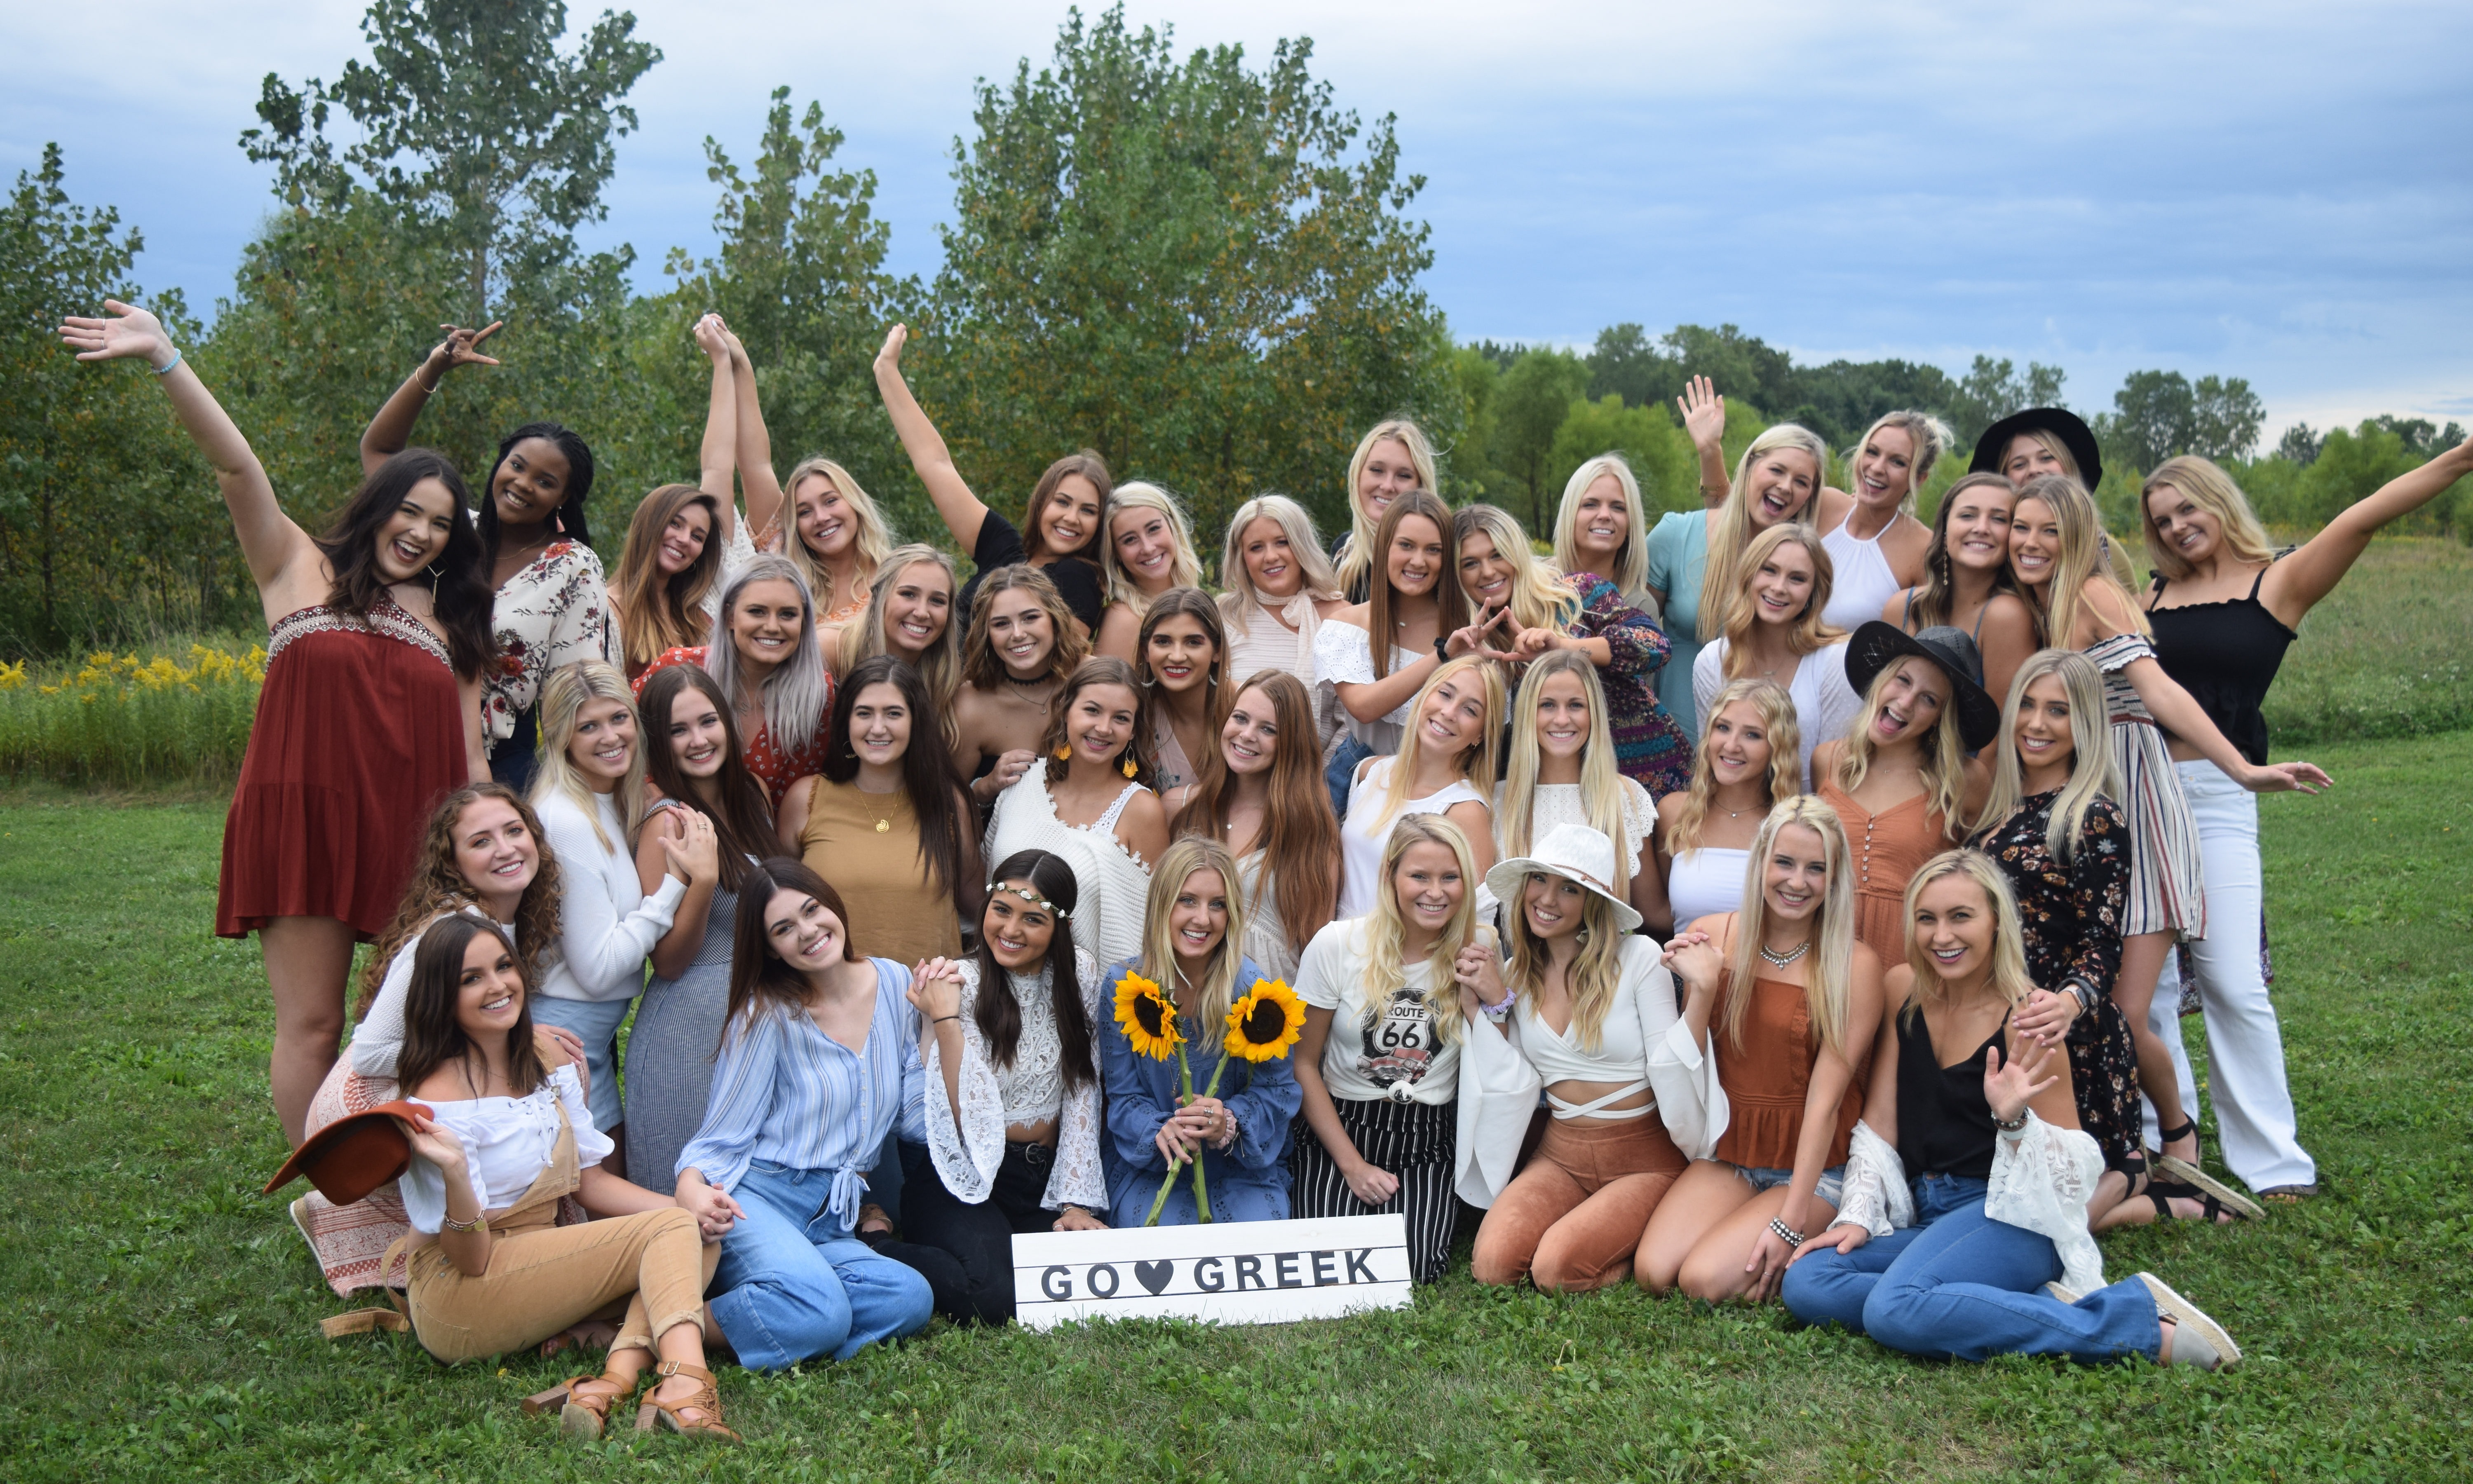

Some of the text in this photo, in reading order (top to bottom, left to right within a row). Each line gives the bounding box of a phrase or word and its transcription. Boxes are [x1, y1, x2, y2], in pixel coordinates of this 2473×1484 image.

[1383, 1021, 1420, 1048] 66
[1041, 1248, 1379, 1300] GO GREEK
